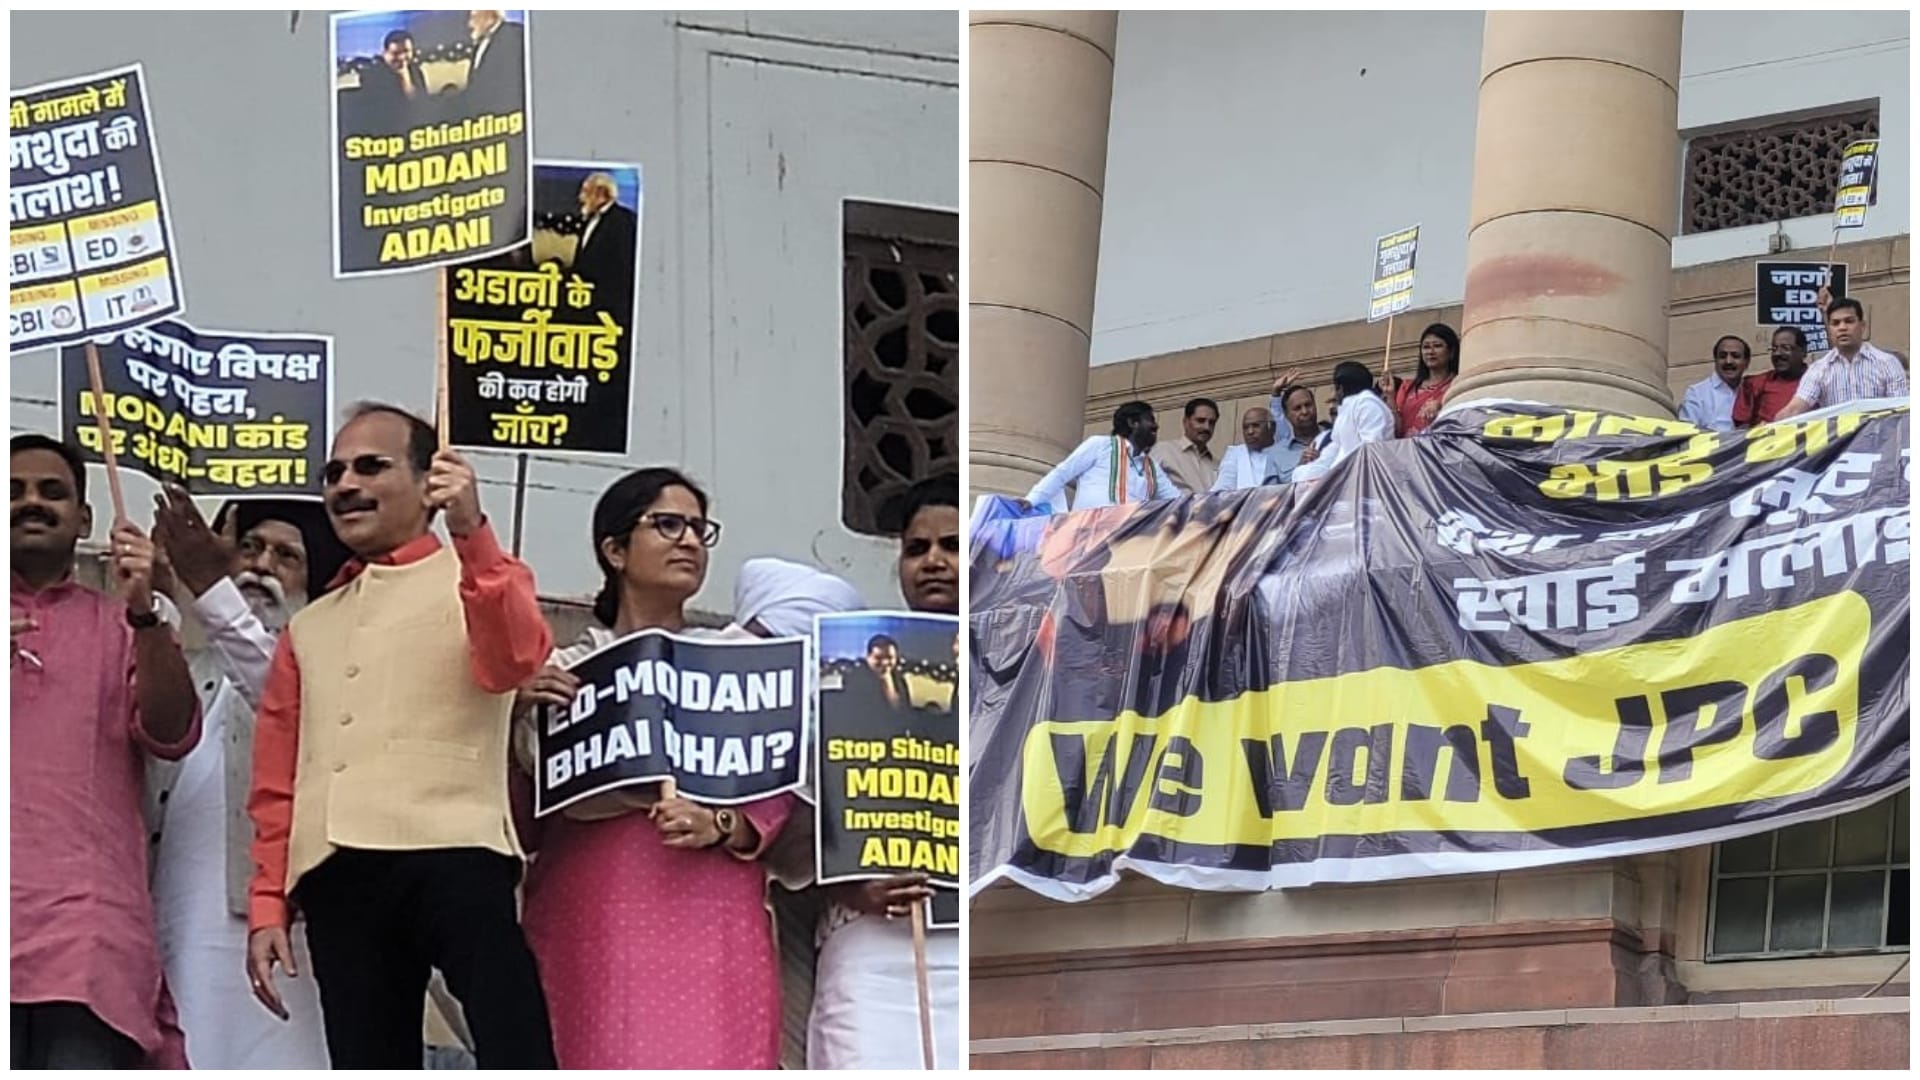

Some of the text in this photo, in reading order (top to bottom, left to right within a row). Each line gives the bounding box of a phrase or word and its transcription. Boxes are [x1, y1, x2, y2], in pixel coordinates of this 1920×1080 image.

[32, 86, 101, 124] मामले
[103, 79, 127, 109] में
[102, 115, 138, 150] की
[345, 111, 523, 158] Stop Shielding
[365, 142, 507, 195] MODANI
[364, 186, 505, 227] Investigate
[86, 237, 118, 261] ED
[380, 216, 491, 262] ADANI
[10, 253, 37, 275] BI
[455, 261, 594, 308] अडानी के
[1770, 266, 1832, 286] जागो
[106, 295, 127, 319] IT
[1770, 307, 1823, 322] जाग
[1785, 289, 1818, 304] ED
[217, 343, 320, 380] विपक्ष
[450, 307, 623, 382] फर्जीवाड़े
[127, 358, 256, 420] पर पहरा,
[477, 371, 588, 403] की कब होगी
[77, 426, 126, 455] पर
[80, 391, 309, 451] MODANI कांड
[491, 399, 568, 446] जाँच?
[1538, 432, 1720, 501] भाई
[1453, 550, 1645, 632] खाई
[547, 659, 794, 736] ED-MODANI
[547, 719, 651, 789] BHAI
[828, 738, 886, 762] Stop
[1048, 652, 1839, 834] We want JPC
[846, 767, 959, 805] MODA
[845, 808, 959, 839] Investiga
[860, 837, 959, 875] ADAN
